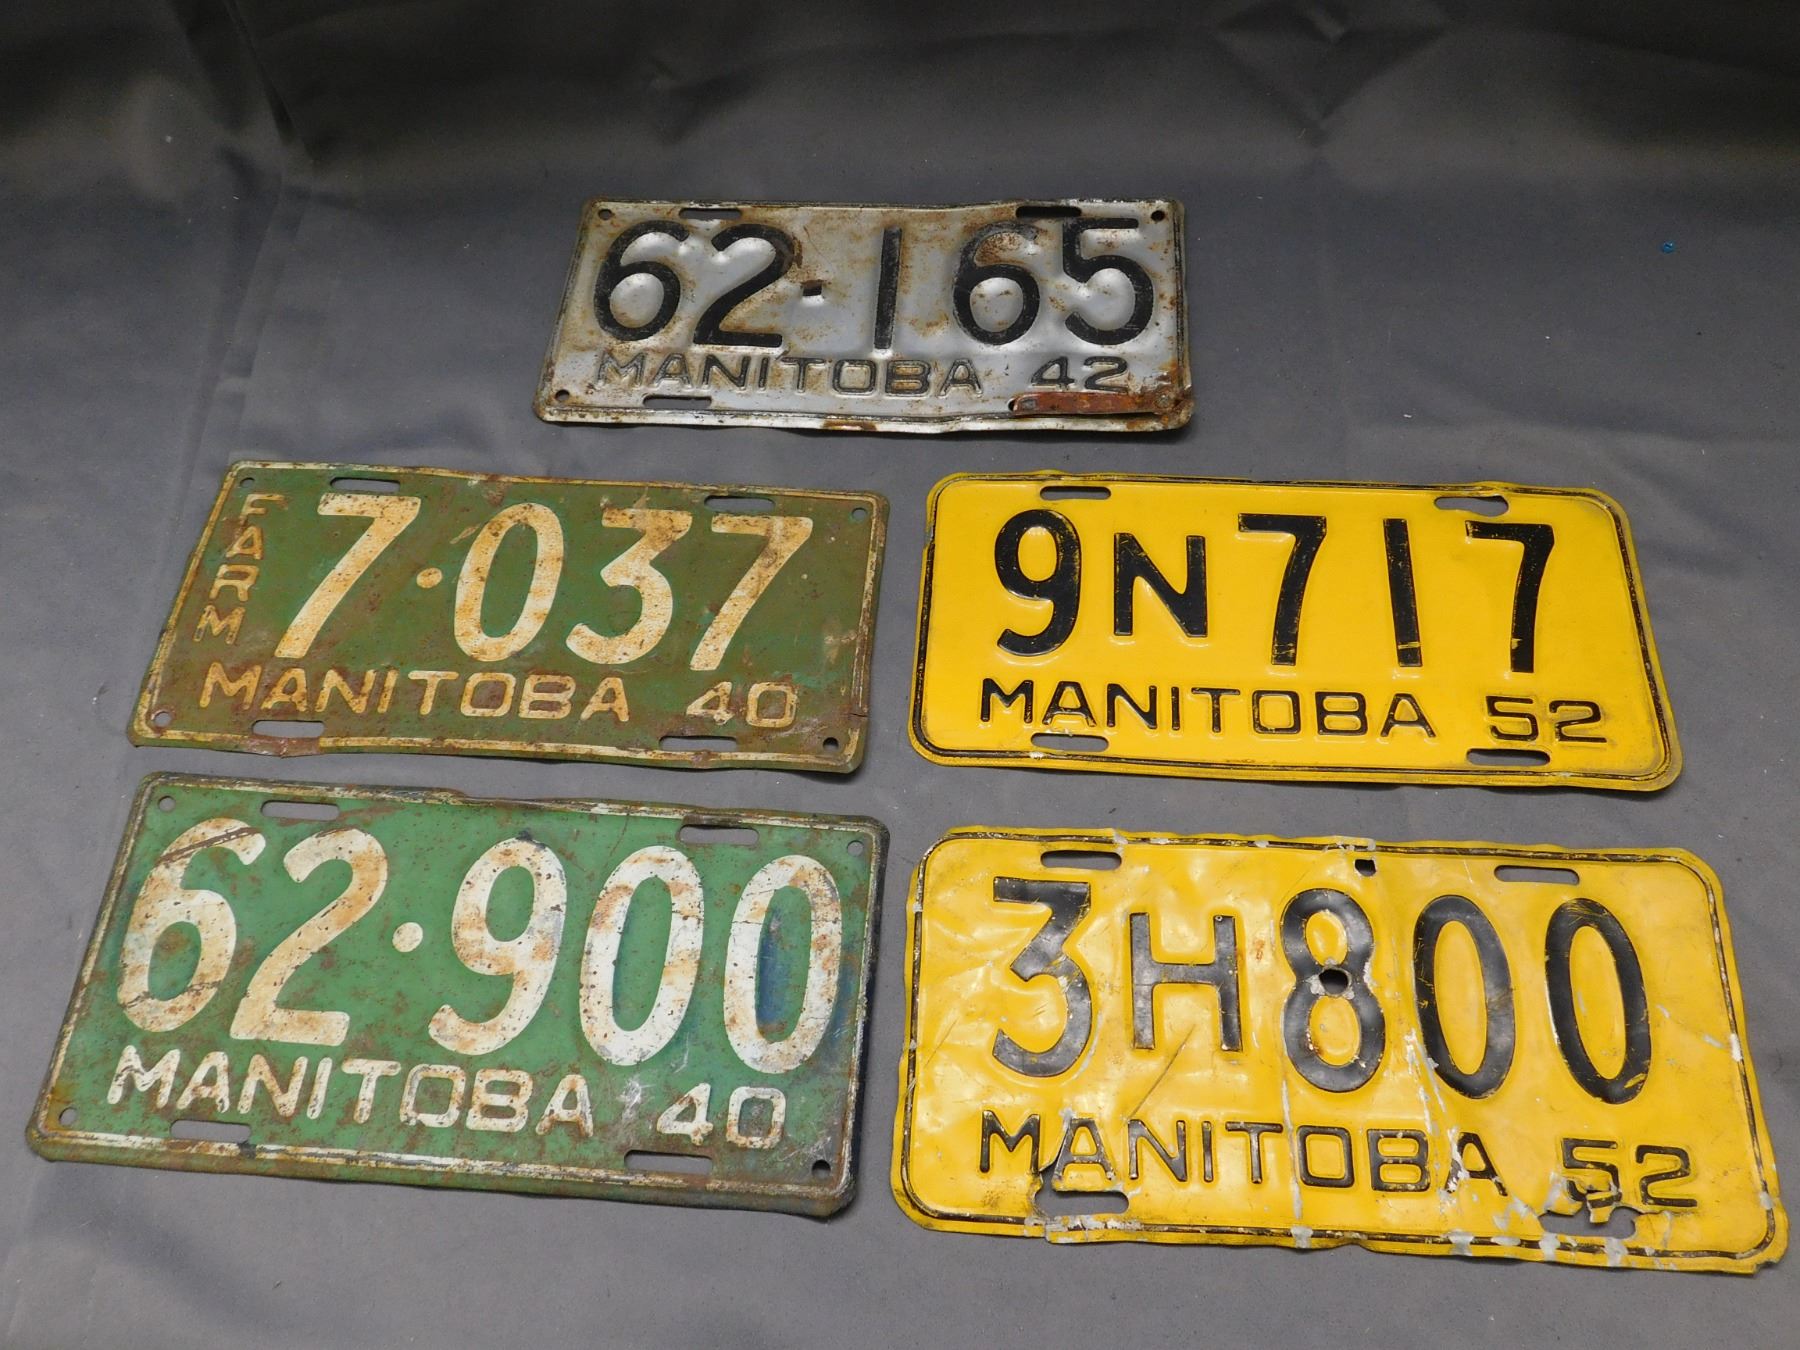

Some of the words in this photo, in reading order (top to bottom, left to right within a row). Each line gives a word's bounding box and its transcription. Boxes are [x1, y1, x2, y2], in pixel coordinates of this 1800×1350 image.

[599, 354, 985, 397] MANITOBA
[1031, 355, 1129, 393] 42
[193, 493, 285, 645] FARM
[994, 508, 1556, 674] 9N717
[199, 661, 630, 722] MANITOBA
[685, 680, 799, 729] 40
[980, 677, 1438, 739] MANITOBA
[1485, 694, 1608, 744] 52
[991, 876, 1654, 1105] 3H800
[106, 1044, 594, 1138] MANITOBA
[656, 1082, 786, 1150] 40
[978, 1109, 1509, 1198] MANITOBA
[1559, 1137, 1699, 1209] 52
